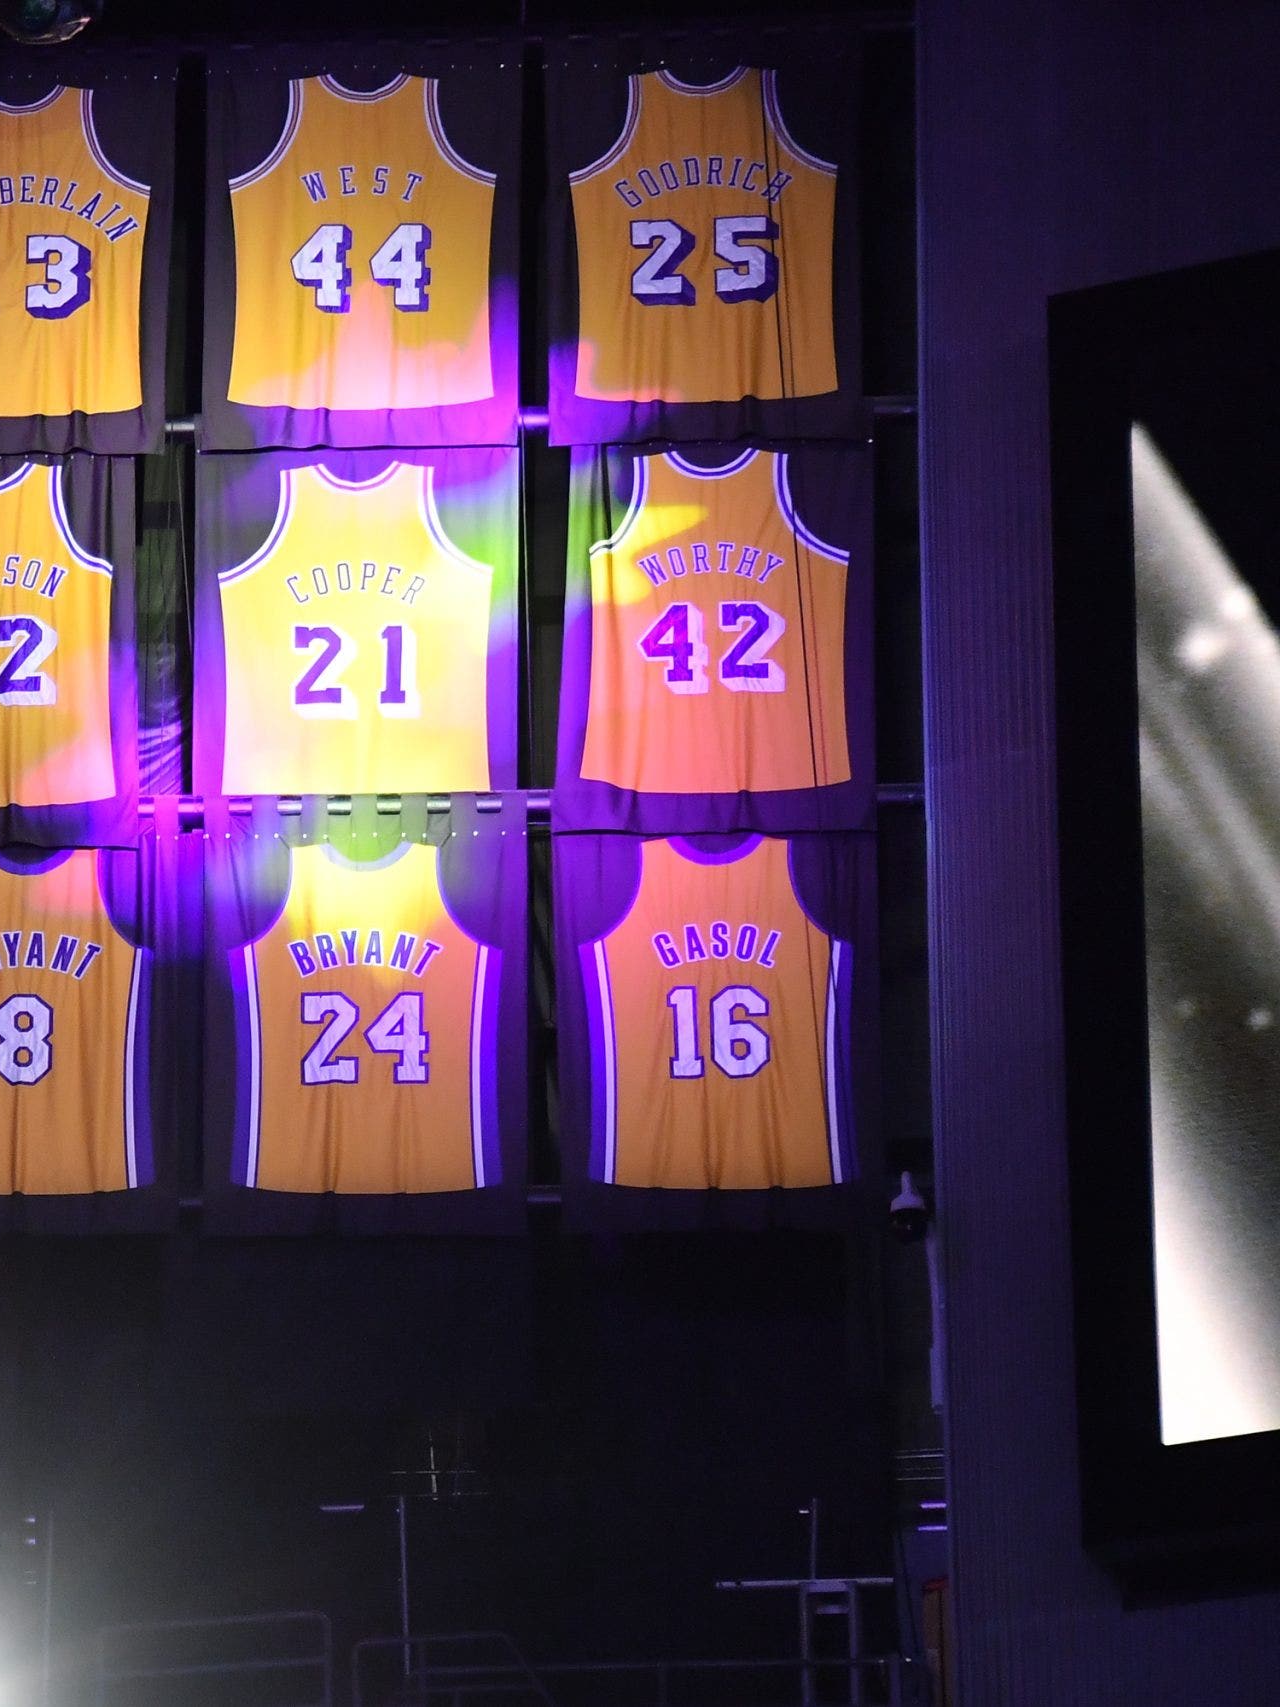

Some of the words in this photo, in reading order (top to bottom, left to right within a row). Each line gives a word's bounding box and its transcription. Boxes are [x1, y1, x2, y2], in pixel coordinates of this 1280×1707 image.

[300, 166, 425, 203] WEST
[614, 156, 792, 208] GOODRICH
[290, 223, 432, 313] 44
[629, 214, 779, 306] 25
[285, 562, 426, 605] COOPER
[638, 542, 784, 587] WORTHY
[291, 624, 420, 720] 21
[635, 600, 785, 695] 42
[288, 929, 443, 978] BRYANT
[651, 921, 783, 971] GASOL
[300, 991, 430, 1085] 24
[667, 984, 771, 1079] 16
